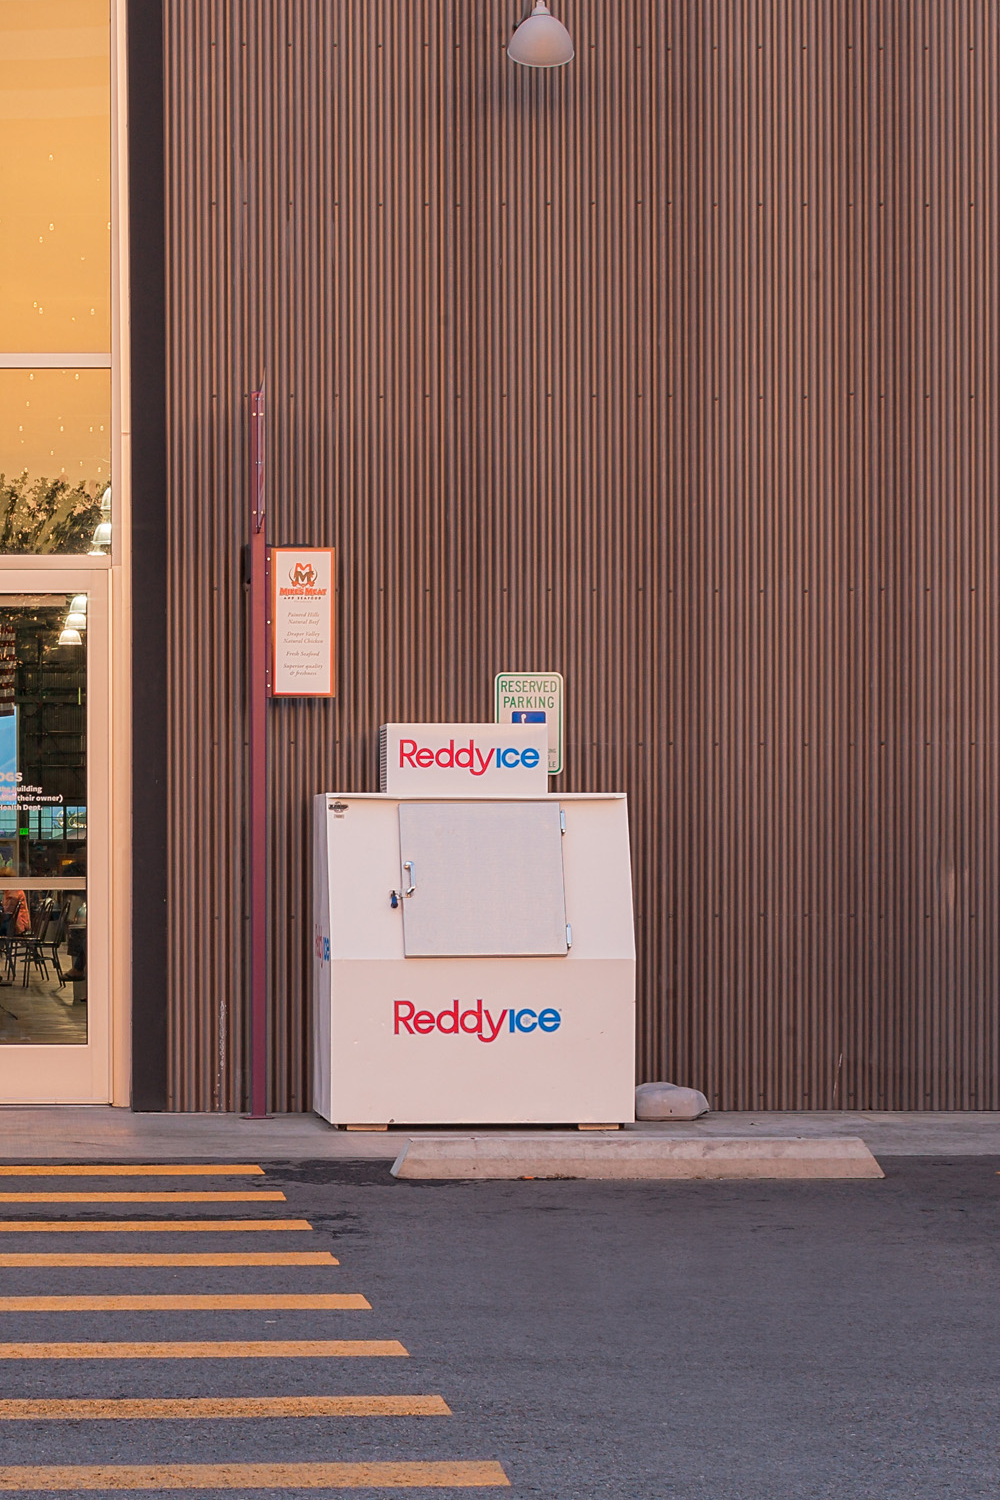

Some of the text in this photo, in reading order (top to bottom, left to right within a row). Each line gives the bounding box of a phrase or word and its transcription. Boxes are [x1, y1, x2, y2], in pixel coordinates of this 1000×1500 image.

[500, 680, 558, 692] RESERVED
[503, 696, 554, 708] PARKING
[12, 785, 43, 794] building
[36, 794, 63, 803] owner)
[22, 804, 43, 812] Dept.
